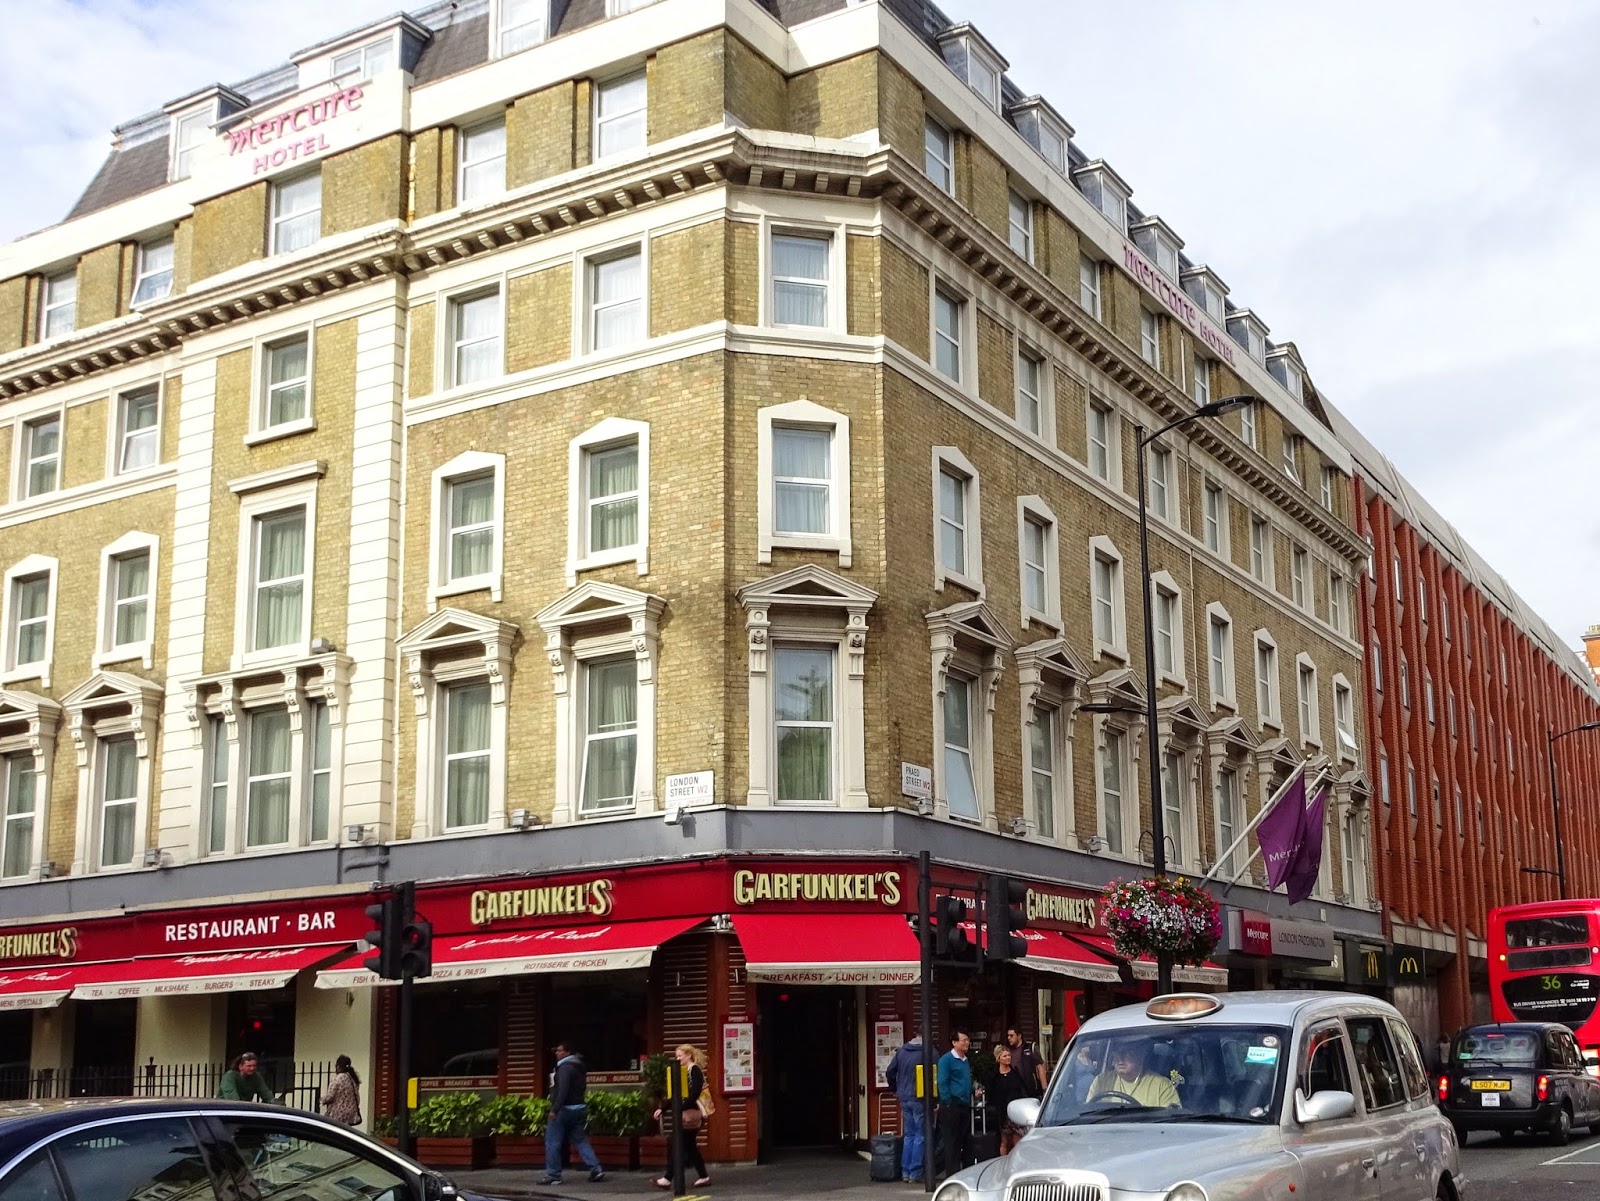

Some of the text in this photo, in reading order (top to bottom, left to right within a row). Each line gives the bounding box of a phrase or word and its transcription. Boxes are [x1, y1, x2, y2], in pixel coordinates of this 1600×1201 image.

[253, 133, 330, 174] HOTEL
[1200, 321, 1236, 367] HOTEL
[670, 776, 699, 787] LONDON
[905, 775, 931, 790] STREET W2
[670, 785, 708, 797] STREET W2
[733, 869, 900, 906] GARFUNKEL'S
[470, 879, 612, 926] GARFUNKEL'S
[1025, 888, 1096, 929] GARFUNKEL'S
[165, 911, 336, 942] RESTAURANT BAR
[1246, 927, 1269, 941] Mercure
[0, 926, 78, 958] RFUNKEL'S
[1279, 932, 1297, 944] LONDON
[523, 958, 608, 970] ROTISSERIE CHICKEN
[432, 970, 453, 979] PIZZA
[465, 967, 487, 975] PASTA
[763, 972, 914, 982] BREAKFAST LUNCH DINNER
[91, 978, 276, 997] TEA COFFEE MILKSHAKE BURGERS STEAKS
[1541, 975, 1561, 990] 36
